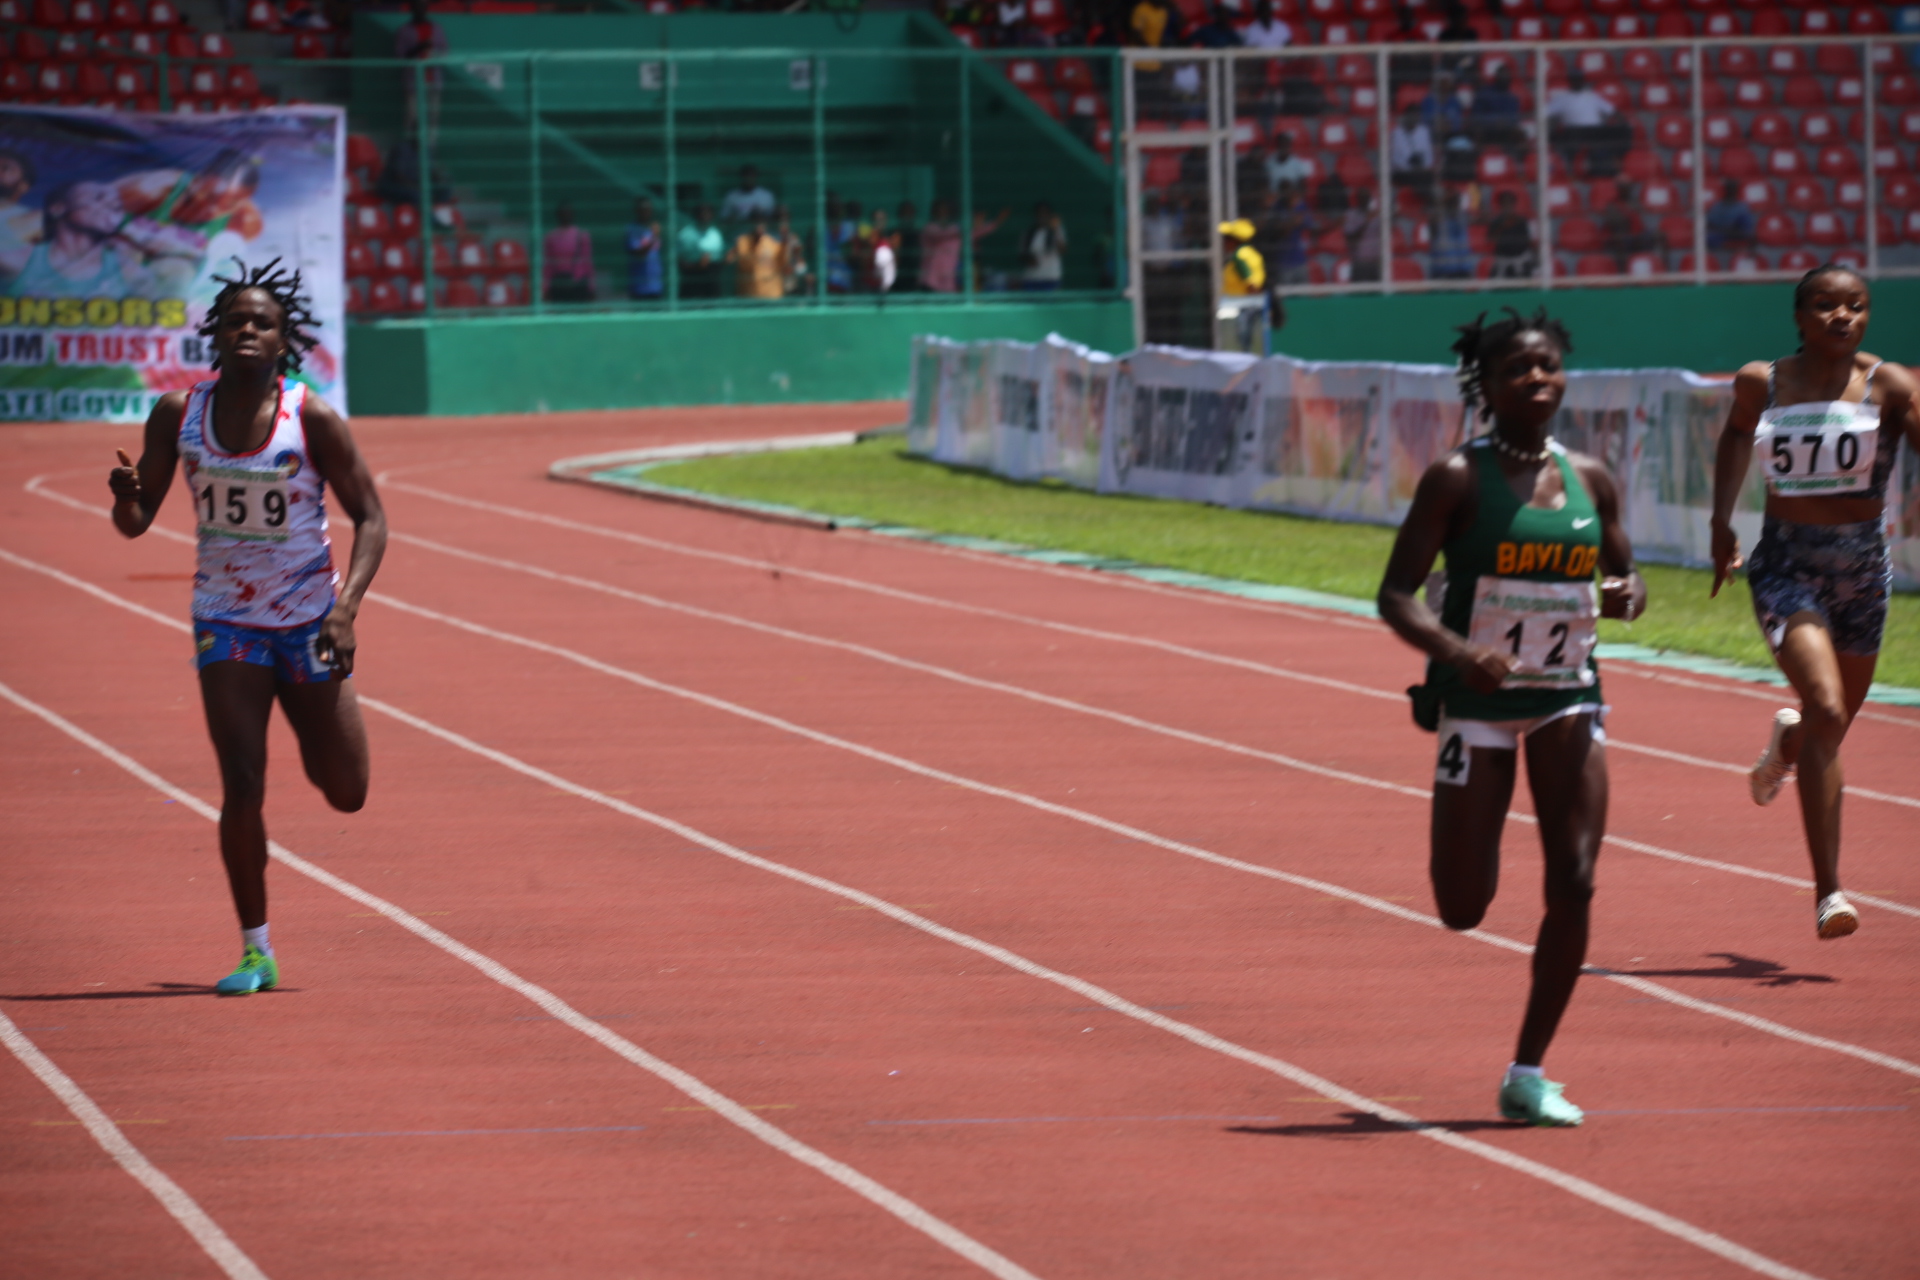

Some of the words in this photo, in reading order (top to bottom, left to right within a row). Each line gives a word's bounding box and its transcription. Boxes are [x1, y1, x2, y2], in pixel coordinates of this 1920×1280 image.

[56, 335, 169, 361] TRUST
[1771, 431, 1858, 476] 570
[201, 483, 287, 527] 159
[1503, 620, 1569, 666] 12
[1438, 731, 1465, 779] 4
